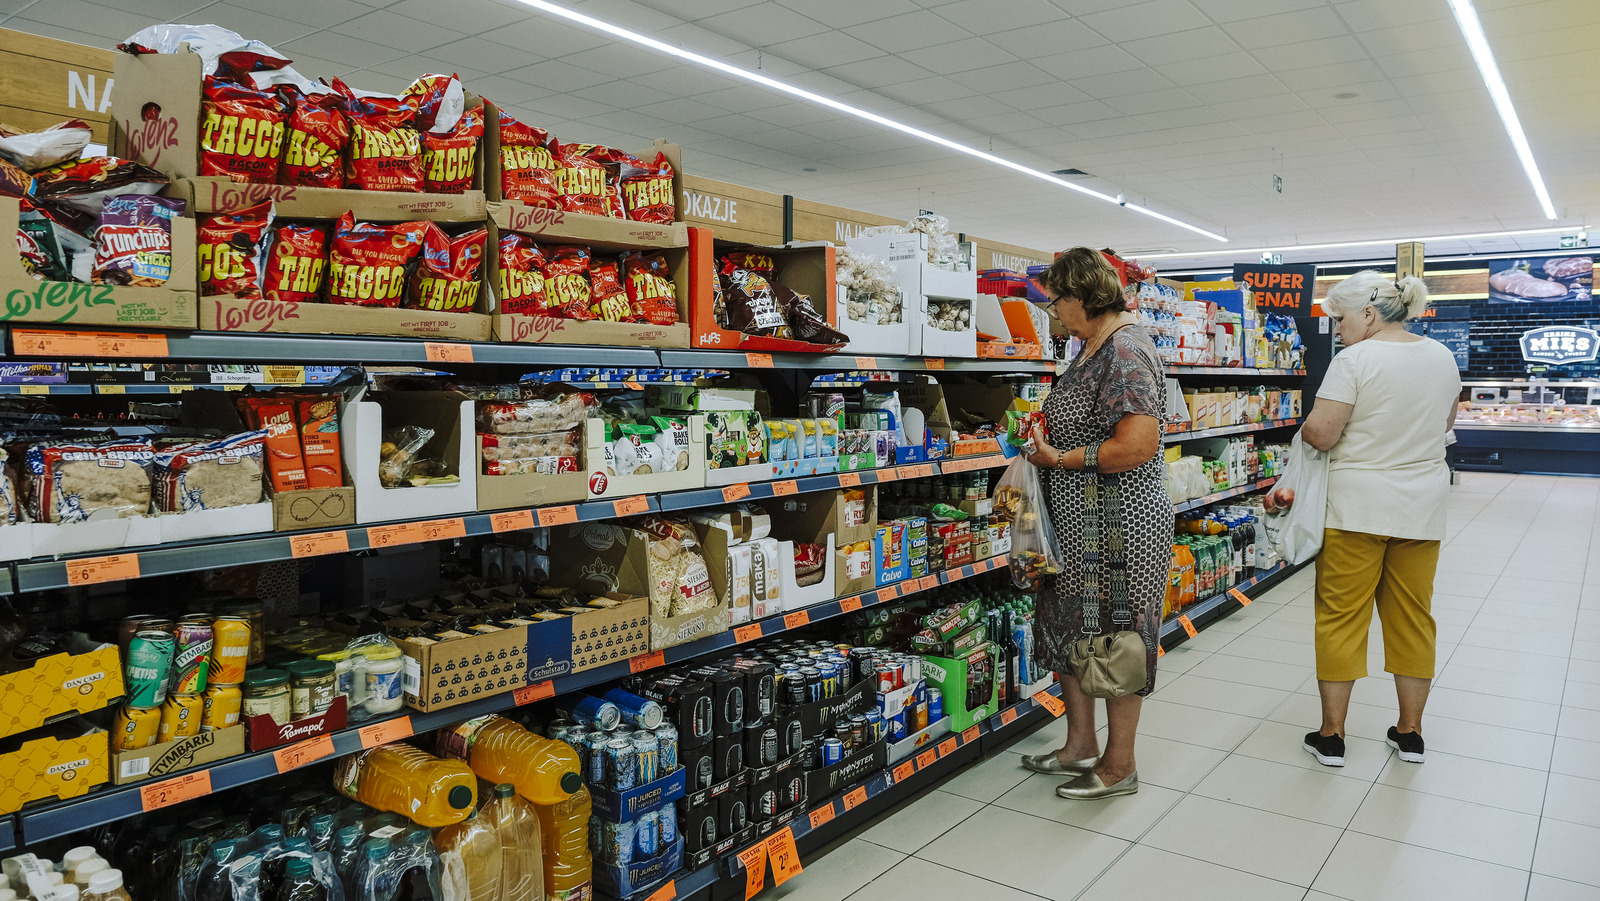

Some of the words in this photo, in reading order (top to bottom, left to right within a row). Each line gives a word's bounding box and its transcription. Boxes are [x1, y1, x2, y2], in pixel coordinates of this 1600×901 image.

[228, 158, 269, 169] BACON
[378, 160, 410, 168] BACON
[517, 171, 542, 179] BACON
[440, 183, 465, 193] BACON
[211, 181, 297, 213] Lorenz
[683, 191, 737, 224] OKAZJE
[509, 205, 565, 234] Lorenz
[99, 229, 170, 259] Crunchips
[136, 251, 171, 267] STICKS
[351, 248, 363, 256] DID
[364, 250, 378, 259] YOU
[424, 242, 450, 268] Lore
[137, 264, 150, 275] XL
[1243, 272, 1304, 289] SUPER
[0, 281, 116, 323] orenz
[136, 302, 147, 310] MY
[508, 298, 536, 308] BACON
[1256, 291, 1301, 308] ENA!
[116, 308, 138, 317] LAST
[139, 308, 156, 316] JOB
[215, 300, 300, 332] Lorenz
[511, 315, 565, 342] Lorenz
[38, 340, 46, 351] 4
[112, 342, 120, 352] 4
[1530, 337, 1590, 352] MIĘS
[440, 350, 446, 359] 6
[0, 365, 30, 377] Milka
[264, 411, 290, 428] Long
[268, 422, 293, 439] Chips
[590, 474, 600, 494] 7
[504, 521, 509, 529] 7
[912, 519, 926, 528] Calvo
[382, 535, 388, 544] 5
[432, 528, 438, 538] 3
[306, 544, 312, 553] 3
[912, 538, 926, 548] Calvo
[910, 557, 926, 567] Calvo
[82, 569, 89, 580] 6
[767, 569, 778, 582] 75
[881, 568, 902, 583] Calvo
[677, 620, 706, 642] SIEKANY
[534, 664, 565, 678] Schulstad
[921, 662, 943, 680] BARK
[66, 679, 82, 689] DAN
[83, 673, 104, 685] CAKE
[523, 691, 528, 700] 4
[645, 689, 664, 701] BLACK
[279, 719, 325, 740] Pamapol
[374, 733, 381, 743] 6
[153, 733, 210, 774] TYMBARK
[294, 754, 300, 764] 7
[50, 765, 66, 774] DAN
[67, 760, 88, 771] CAKE
[776, 758, 792, 772] BLACK
[839, 753, 874, 777] MONSTER
[637, 788, 662, 802] JUICED
[711, 781, 730, 795] BLACK
[160, 792, 167, 803] 2
[777, 810, 794, 823] BLACK
[716, 837, 734, 852] BLACK
[778, 855, 785, 871] 2
